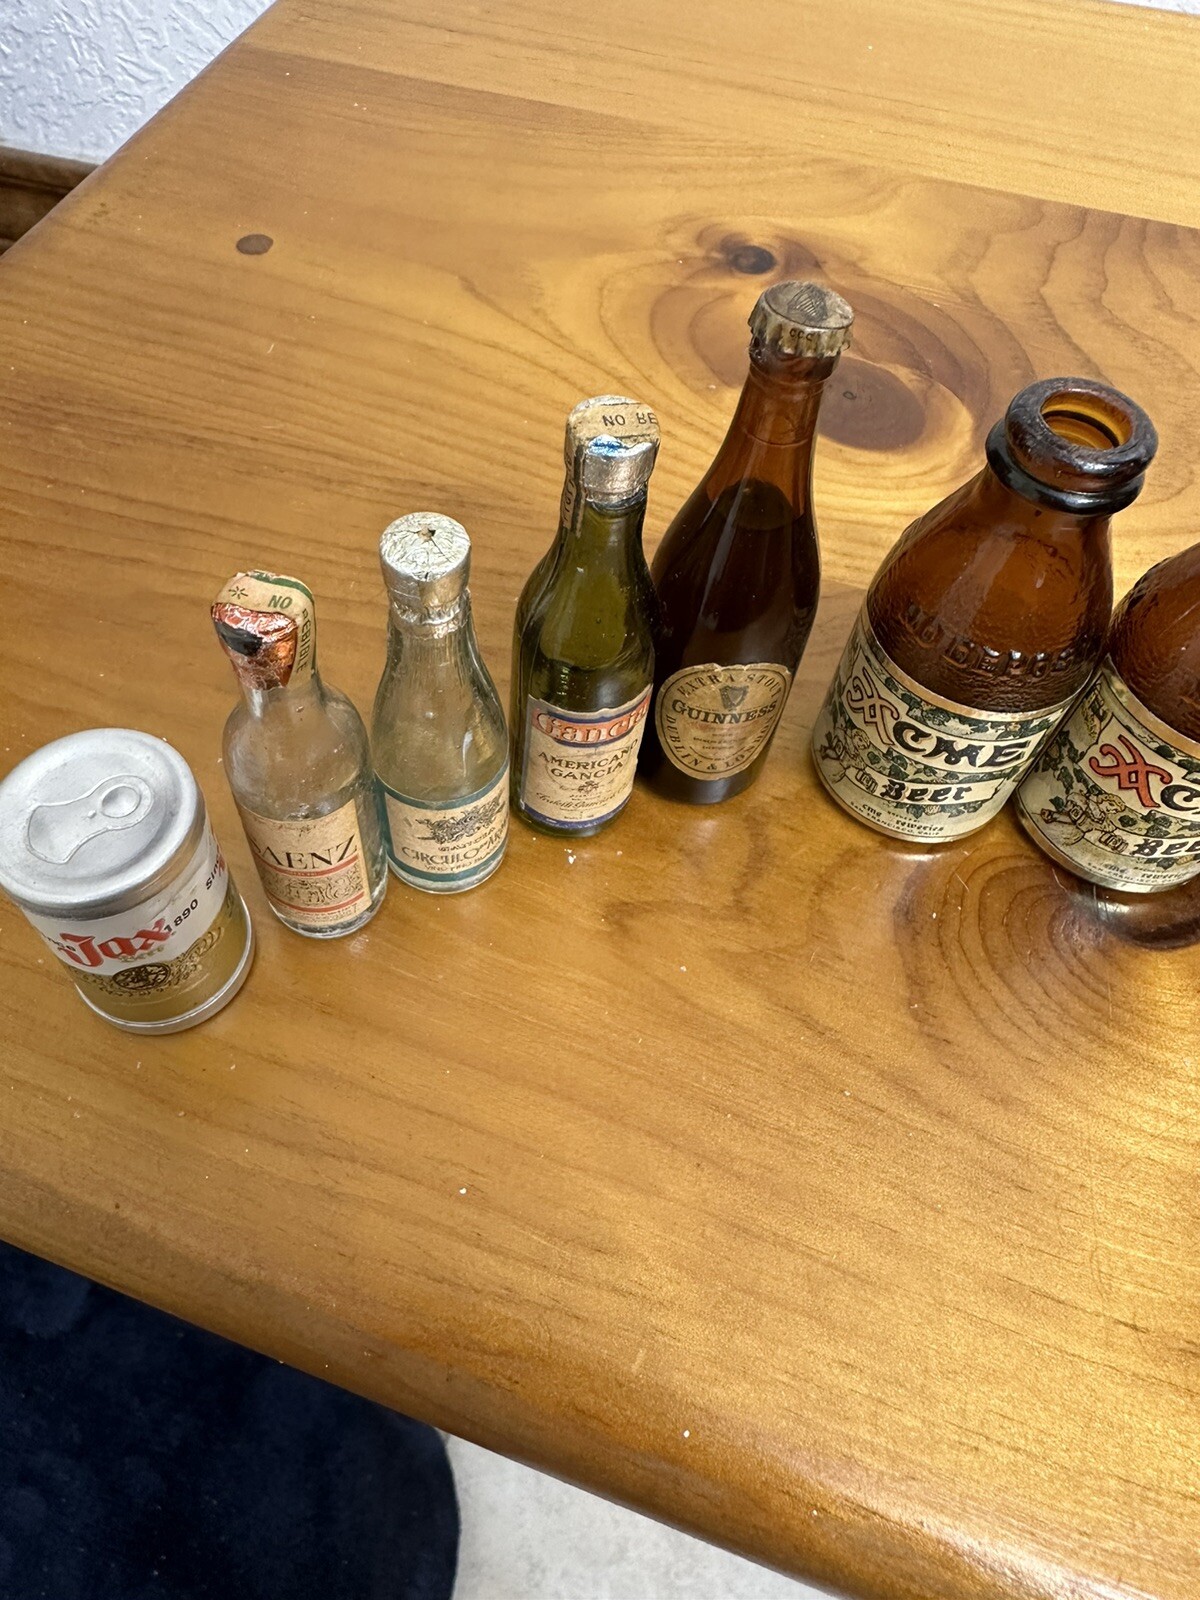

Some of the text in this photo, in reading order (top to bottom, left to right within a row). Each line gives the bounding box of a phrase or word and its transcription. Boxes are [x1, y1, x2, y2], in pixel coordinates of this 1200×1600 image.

[602, 414, 626, 426] NO
[267, 595, 293, 609] NO
[676, 673, 735, 698] EXTRA
[671, 698, 778, 725] GUINNESS
[665, 714, 703, 766] DUBLIN
[538, 738, 638, 770] AMERICANO
[550, 761, 624, 780] GANCIA
[879, 779, 973, 801] Beer
[164, 898, 199, 934] 1890
